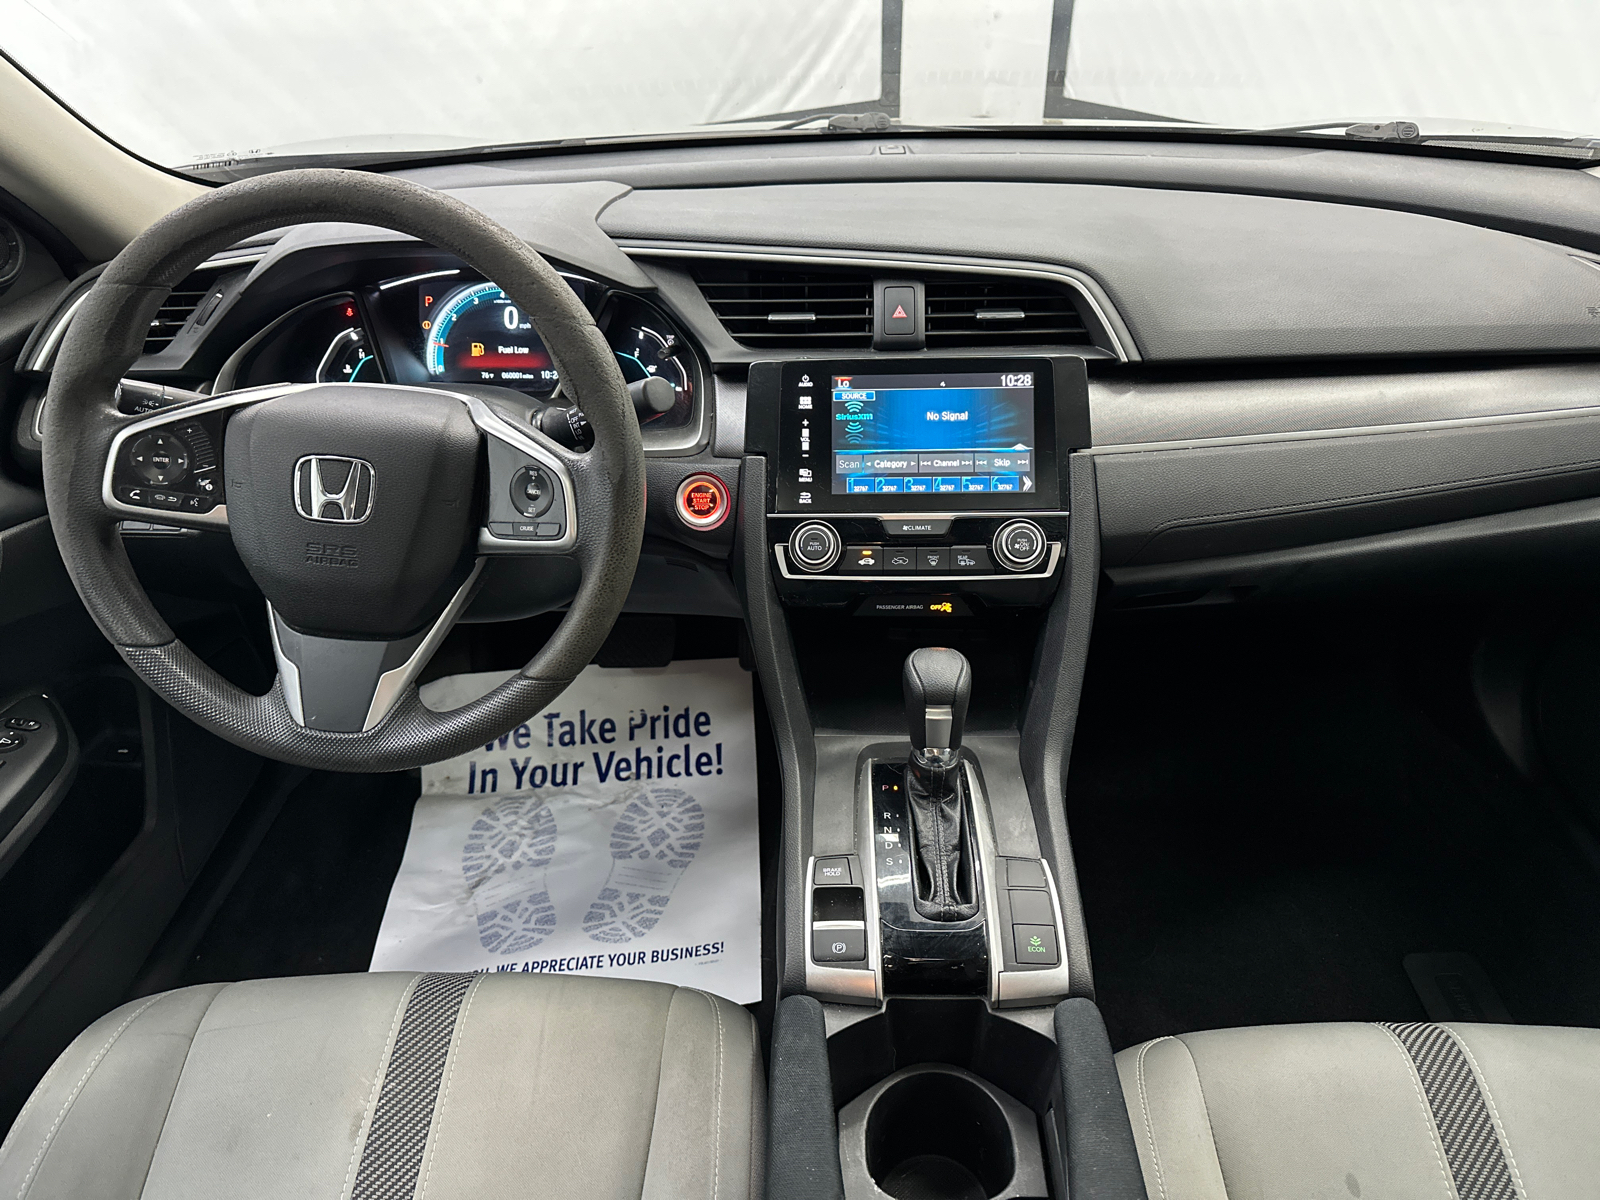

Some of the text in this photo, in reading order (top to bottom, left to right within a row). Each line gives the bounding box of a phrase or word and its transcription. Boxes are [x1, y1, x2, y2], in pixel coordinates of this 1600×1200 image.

[424, 295, 433, 307] P
[504, 306, 518, 329] 0
[498, 345, 529, 354] Fuel Low
[541, 370, 559, 380] 10:2
[838, 379, 850, 388] Lo
[1000, 374, 1032, 387] 10:28
[841, 392, 867, 400] SOURCE
[926, 410, 969, 422] No Signal
[838, 459, 860, 469] Scan
[874, 459, 908, 469] Category
[933, 459, 960, 467] Channel
[994, 458, 1011, 467] Skip
[306, 543, 358, 558] SRS
[305, 556, 359, 568] AIRBAG
[543, 709, 617, 747] Take
[628, 704, 712, 741] Pride
[468, 743, 723, 794] In Your Vehicle!
[883, 826, 892, 834] N
[884, 841, 893, 849] D
[885, 857, 894, 866] S
[521, 954, 605, 973] APPRECIATE
[608, 951, 646, 967] YOUR
[650, 941, 725, 963] BUSINESS!
